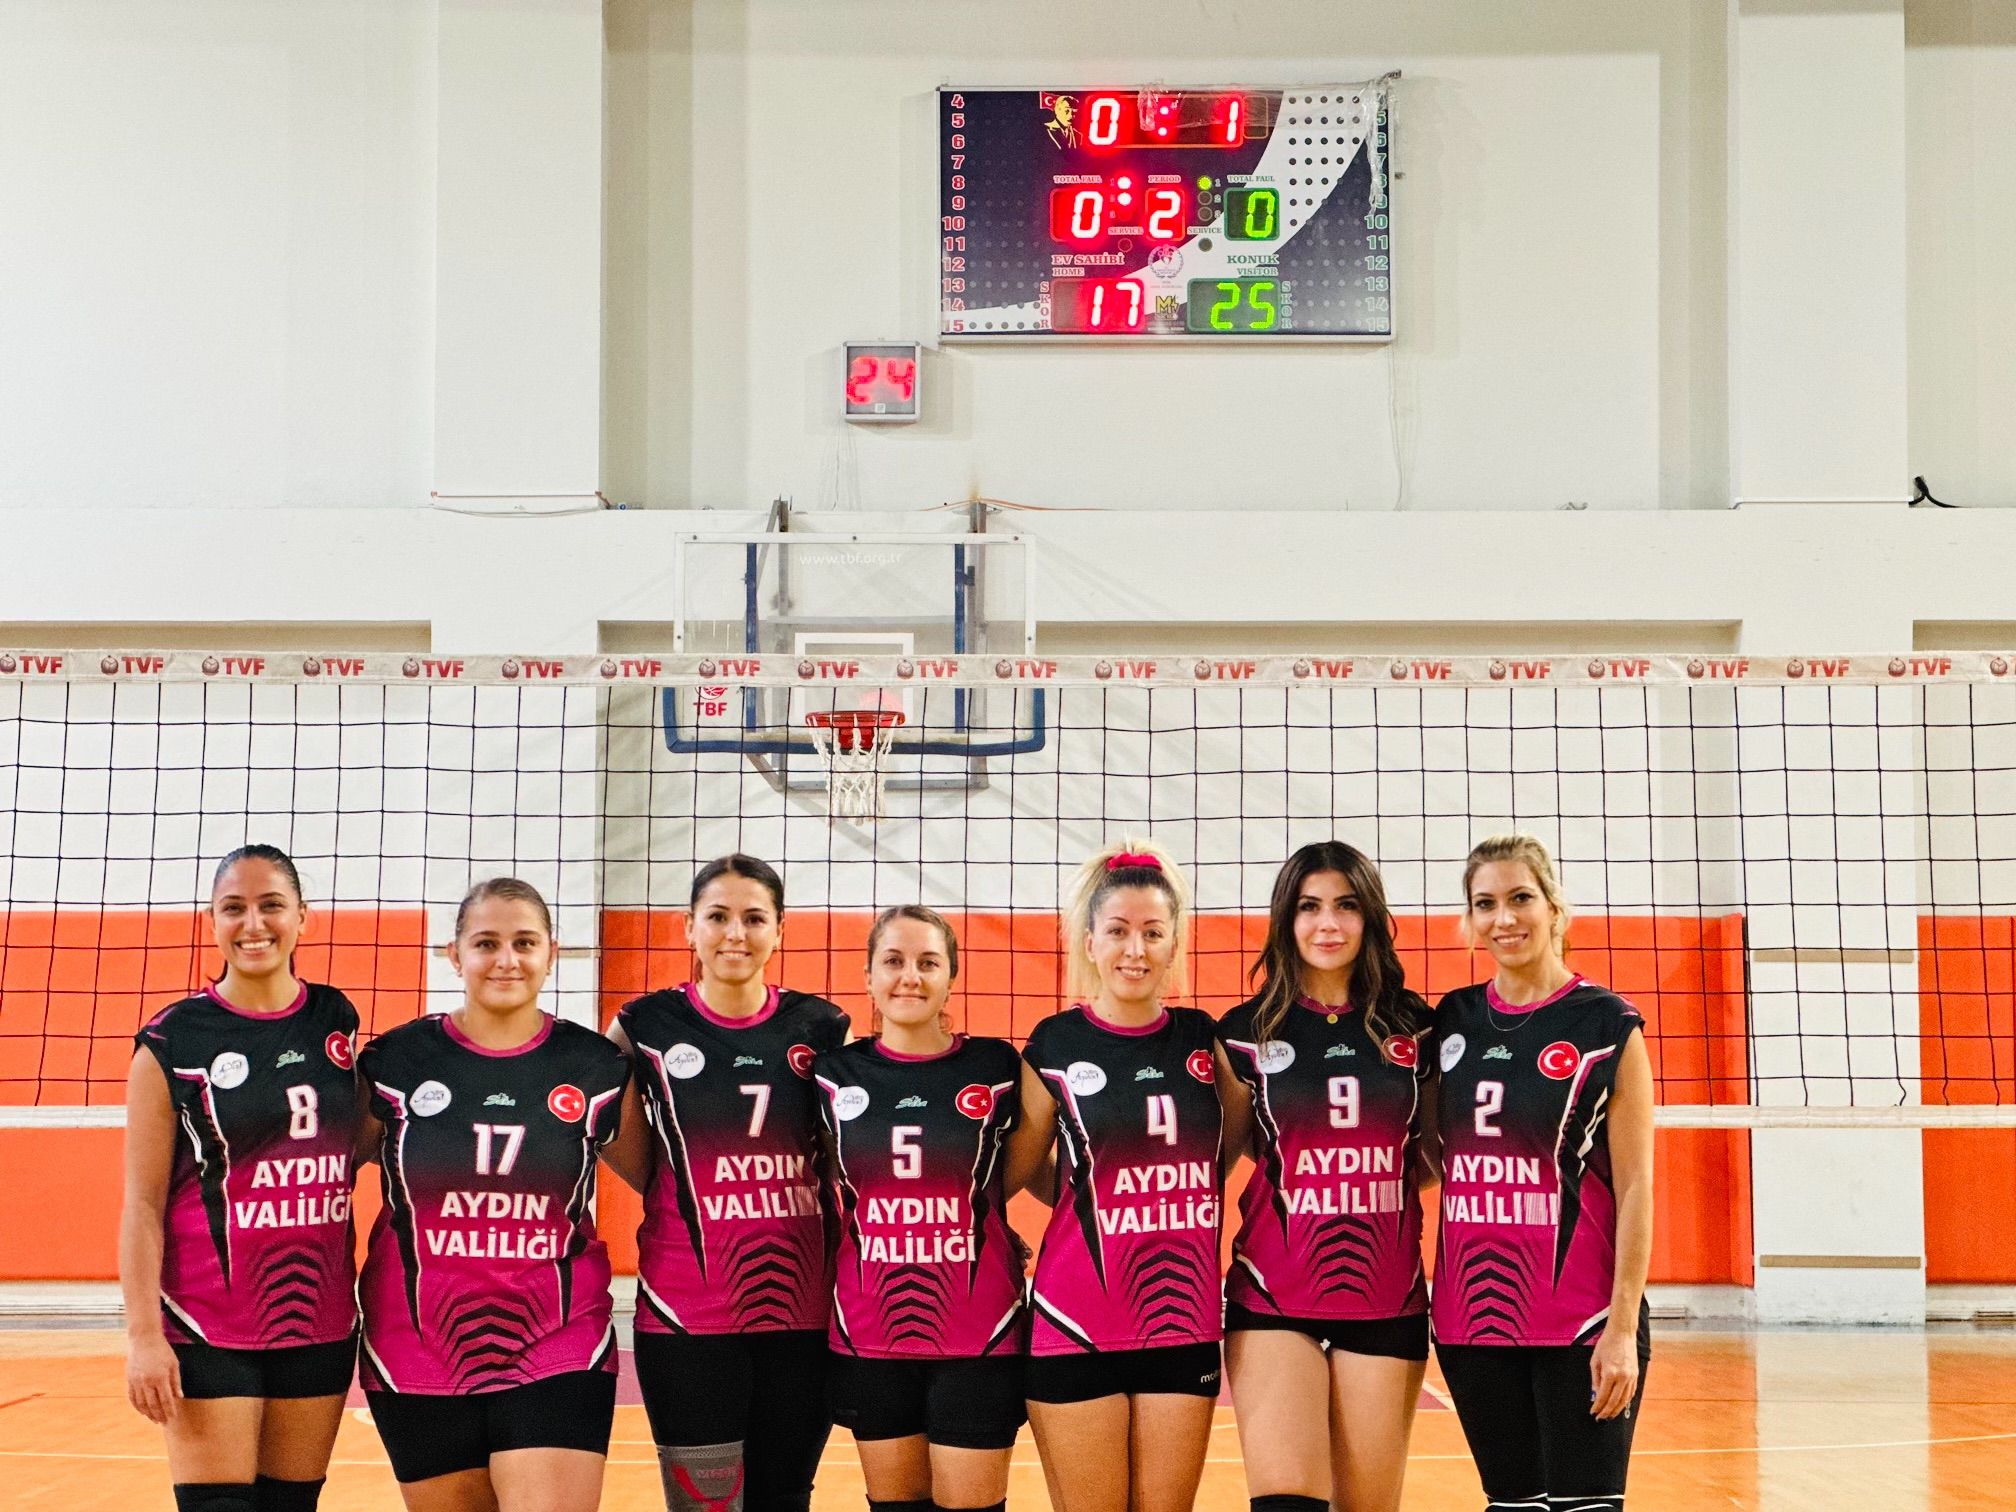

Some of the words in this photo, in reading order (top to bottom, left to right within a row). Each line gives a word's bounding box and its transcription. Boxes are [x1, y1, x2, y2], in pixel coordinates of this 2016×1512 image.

[951, 94, 965, 109] 4
[952, 113, 965, 128] 5
[1089, 97, 1120, 146] 0
[1226, 100, 1239, 143] 1
[952, 134, 965, 149] 6
[951, 155, 965, 170] 7
[952, 175, 965, 190] 8
[1053, 175, 1080, 184] TOTAL
[1081, 175, 1102, 184] FAUL
[1148, 175, 1181, 183] PERIOD
[1228, 175, 1253, 183] TOTAL
[1255, 175, 1275, 183] FAUL
[952, 195, 965, 210] 9
[1071, 190, 1103, 239] 0
[1149, 190, 1181, 238] 2
[1245, 191, 1275, 238] 0
[1364, 214, 1388, 229] 10
[942, 215, 965, 231] 10
[1108, 226, 1144, 235] SERVICE
[1187, 226, 1222, 235] SERVICE
[944, 236, 965, 251] 11
[1366, 235, 1388, 250] 11
[942, 257, 965, 272] 12
[1052, 254, 1073, 265] EV
[1074, 252, 1125, 265] SAHİBİ
[1227, 254, 1279, 264] KONUK
[1365, 255, 1388, 270] 12
[1052, 267, 1085, 277] HOME
[1237, 267, 1279, 276] VISITOR
[942, 278, 965, 292] 13
[1365, 276, 1389, 291] 13
[942, 298, 965, 312] 14
[1039, 281, 1051, 329] SKOR
[1091, 282, 1140, 327] 17
[1210, 282, 1275, 329] 25
[1281, 280, 1293, 329] SKOR
[1365, 297, 1389, 312] 14
[943, 319, 965, 332] 15
[1366, 317, 1389, 332] 15
[846, 356, 915, 405] 24
[20, 656, 62, 674] TVF
[122, 657, 163, 673] TVF
[222, 658, 264, 675] TVF
[322, 659, 364, 676] TVF
[422, 660, 463, 678] TVF
[522, 661, 563, 678] TVF
[620, 660, 661, 677] TVF
[718, 660, 760, 677] TVF
[818, 662, 859, 679] TVF
[917, 661, 958, 678] TVF
[1016, 661, 1057, 678] TVF
[1115, 662, 1156, 679] TVF
[1215, 662, 1256, 679] TVF
[1313, 661, 1353, 678] TVF
[1411, 662, 1452, 680] TVF
[1509, 662, 1550, 679] TVF
[1608, 660, 1650, 677] TVF
[1707, 661, 1749, 678] TVF
[1807, 660, 1849, 677] TVF
[1908, 659, 1951, 676] TVF
[693, 702, 727, 716] TBF
[1328, 1075, 1360, 1129] 9
[1474, 1080, 1504, 1137] 2
[286, 1084, 318, 1140] 8
[739, 1084, 771, 1138] 7
[1146, 1094, 1178, 1146] 4
[472, 1122, 526, 1175] 17
[892, 1125, 923, 1179] 5
[715, 1154, 804, 1183] AYDIN
[1295, 1146, 1393, 1175] AYDIN
[251, 1154, 346, 1188] AYDIN
[1451, 1155, 1540, 1184] AYDIN
[1113, 1161, 1211, 1195] AYDIN
[440, 1191, 550, 1221] AYDIN
[867, 1197, 960, 1224] AYDIN
[1098, 1194, 1220, 1236] VALİLİĞİ
[425, 1226, 558, 1260] VALİLİĞİ
[858, 1228, 976, 1264] VALİLİĞİ
